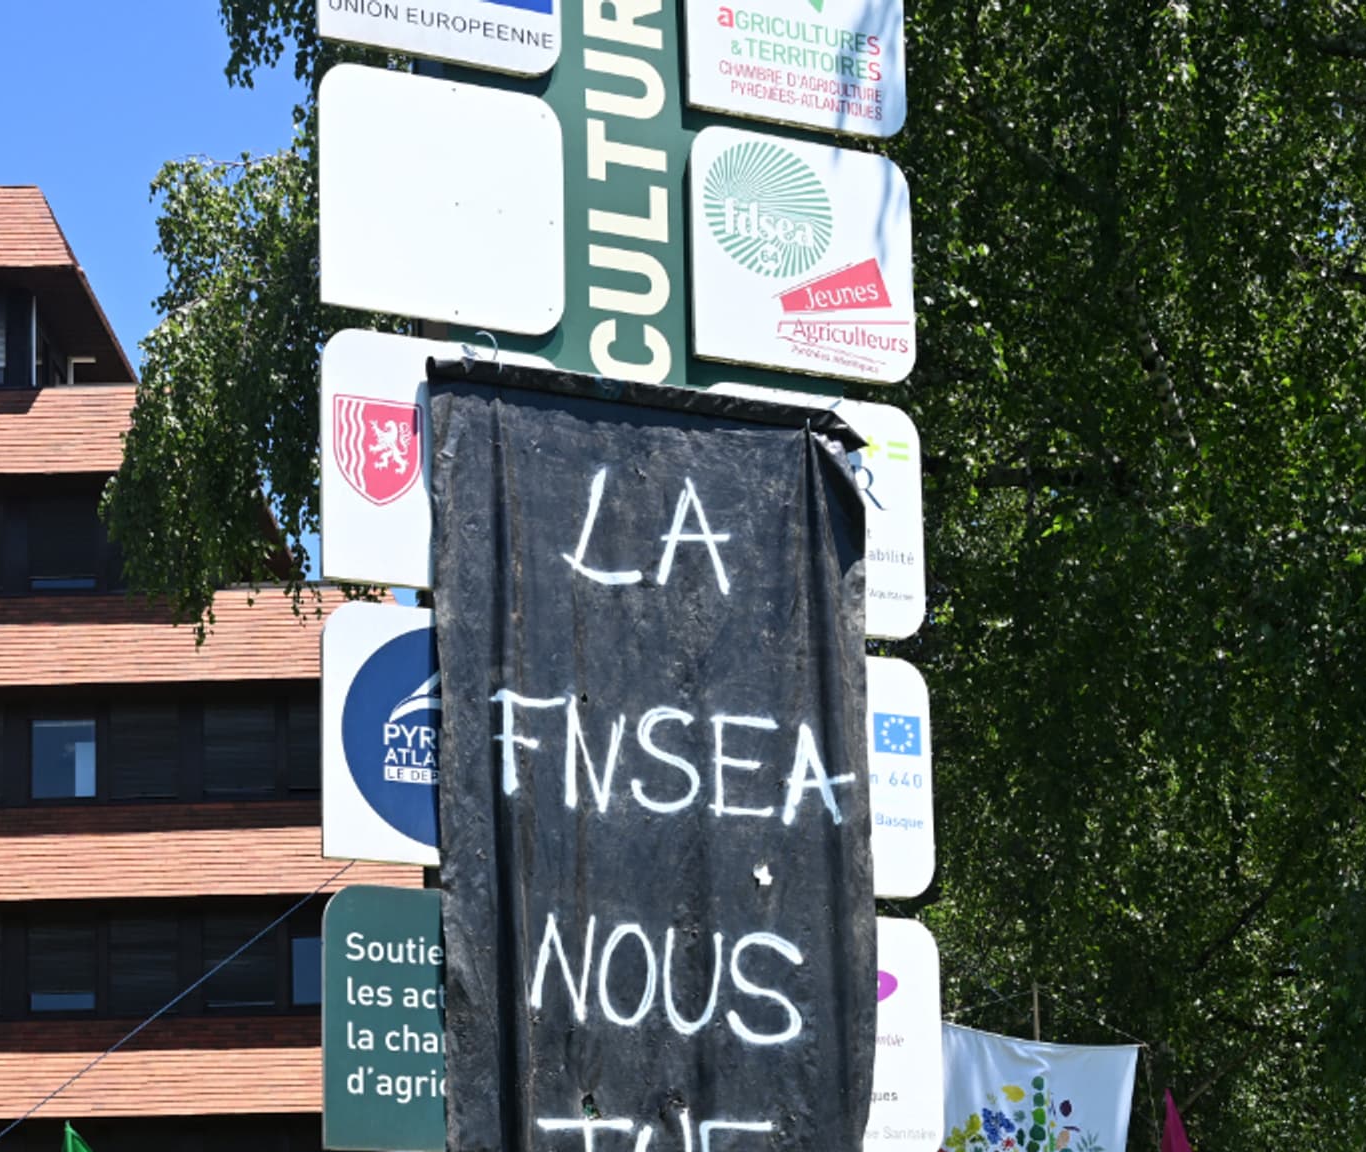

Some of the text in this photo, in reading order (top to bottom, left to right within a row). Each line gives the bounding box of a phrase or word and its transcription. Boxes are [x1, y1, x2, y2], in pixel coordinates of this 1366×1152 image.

[406, 8, 554, 49] EUROPEENNE
[744, 37, 882, 81] TERRITOIRES
[719, 60, 882, 103] CHAMBRE D'AGRICULTURE
[761, 251, 779, 265] 64
[804, 283, 879, 311] Jeunes
[793, 317, 910, 355] Agriculteurs
[563, 467, 731, 594] LA
[387, 767, 404, 780] LE
[492, 689, 855, 824] FNSEA
[888, 770, 923, 789] 640
[874, 811, 923, 831] Basque
[347, 976, 393, 1006] les
[530, 913, 803, 1044] NOUS
[347, 1021, 374, 1050] la
